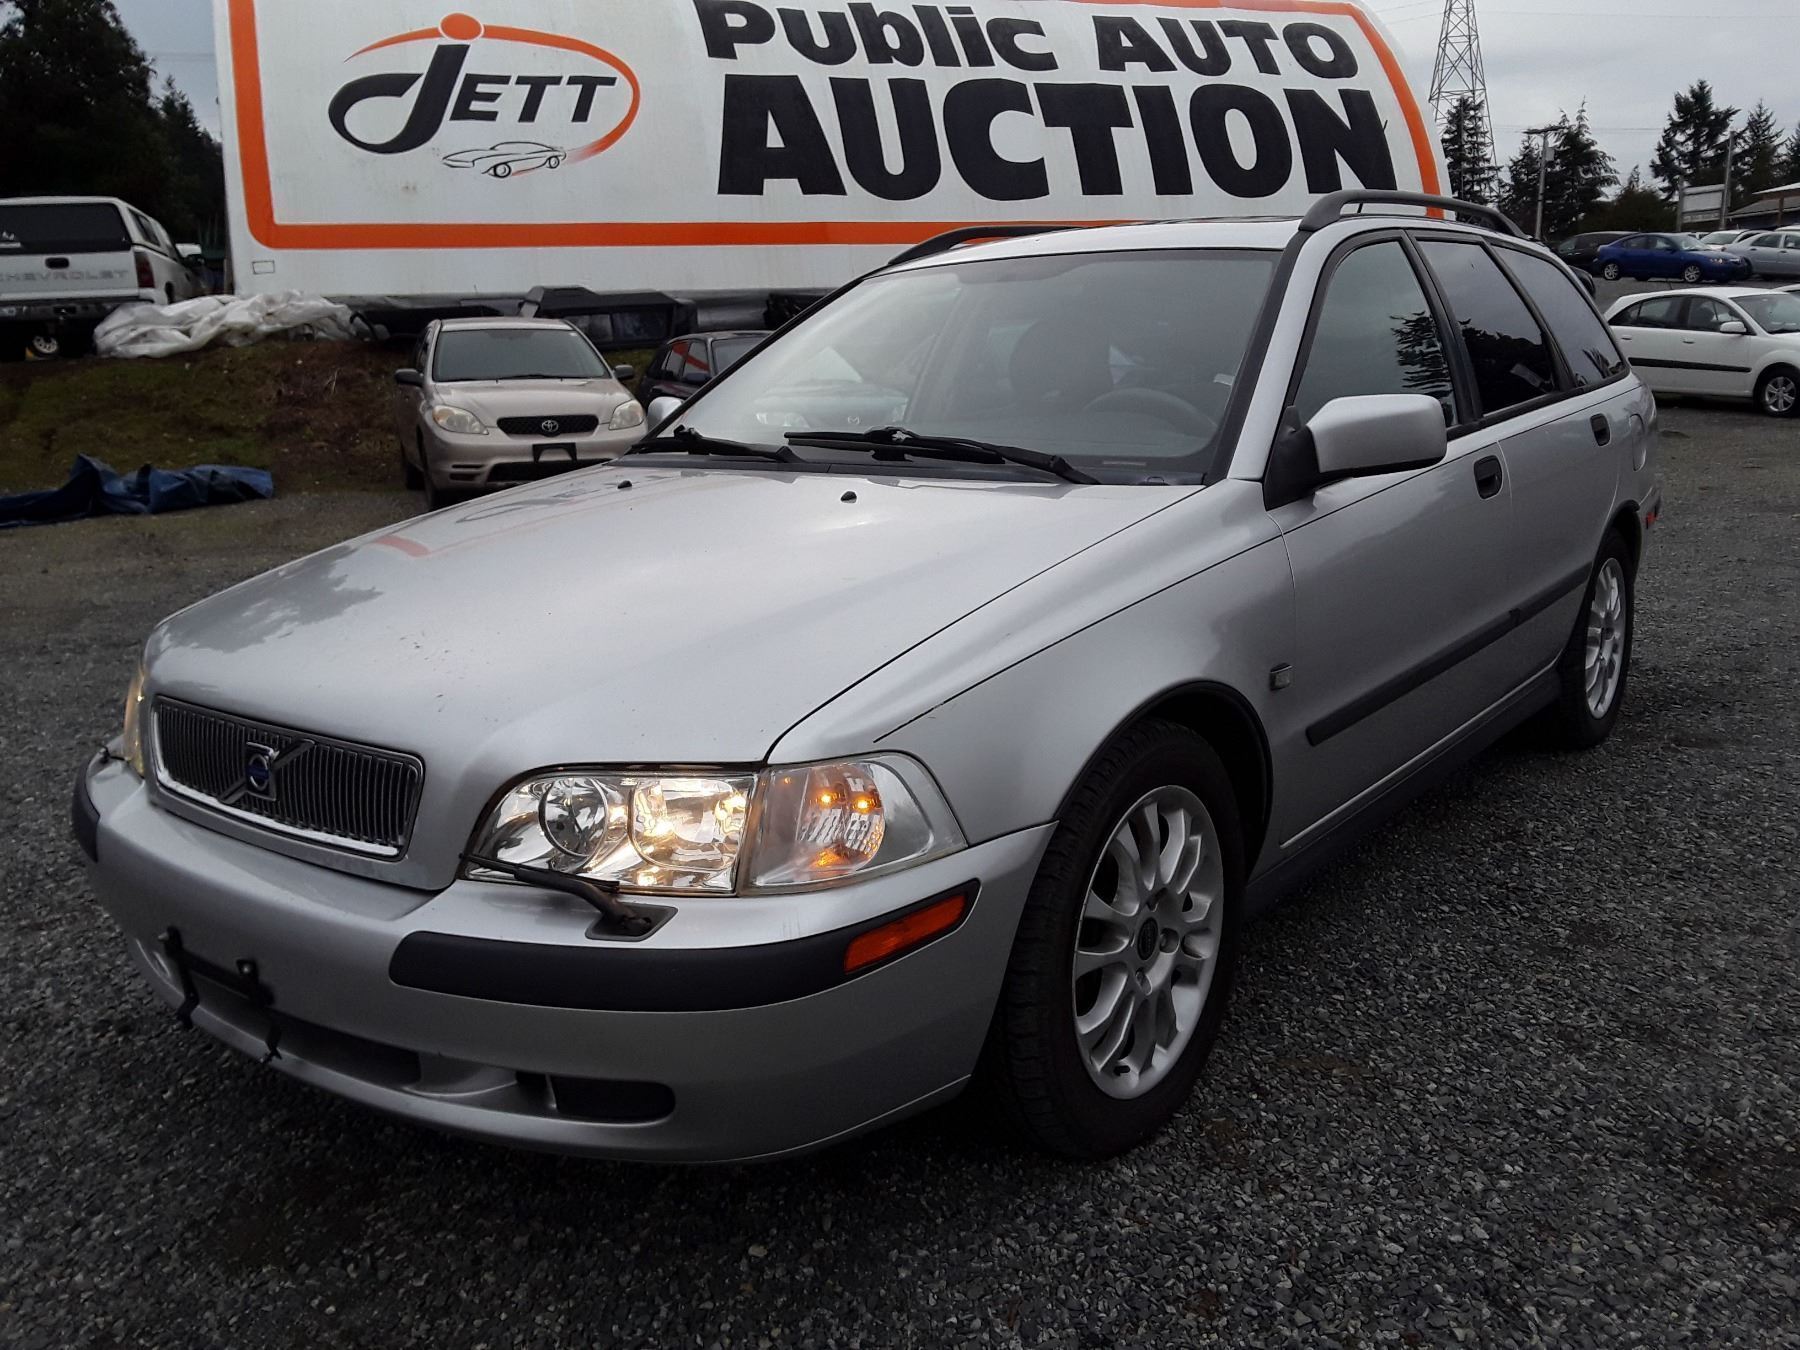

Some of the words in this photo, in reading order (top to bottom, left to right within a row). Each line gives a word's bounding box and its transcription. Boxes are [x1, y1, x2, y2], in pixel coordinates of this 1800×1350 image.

[1092, 15, 1358, 78] AUTO
[328, 43, 617, 155] JETT
[718, 73, 1397, 202] AUCTION
[0, 270, 128, 281] HEVROLET
